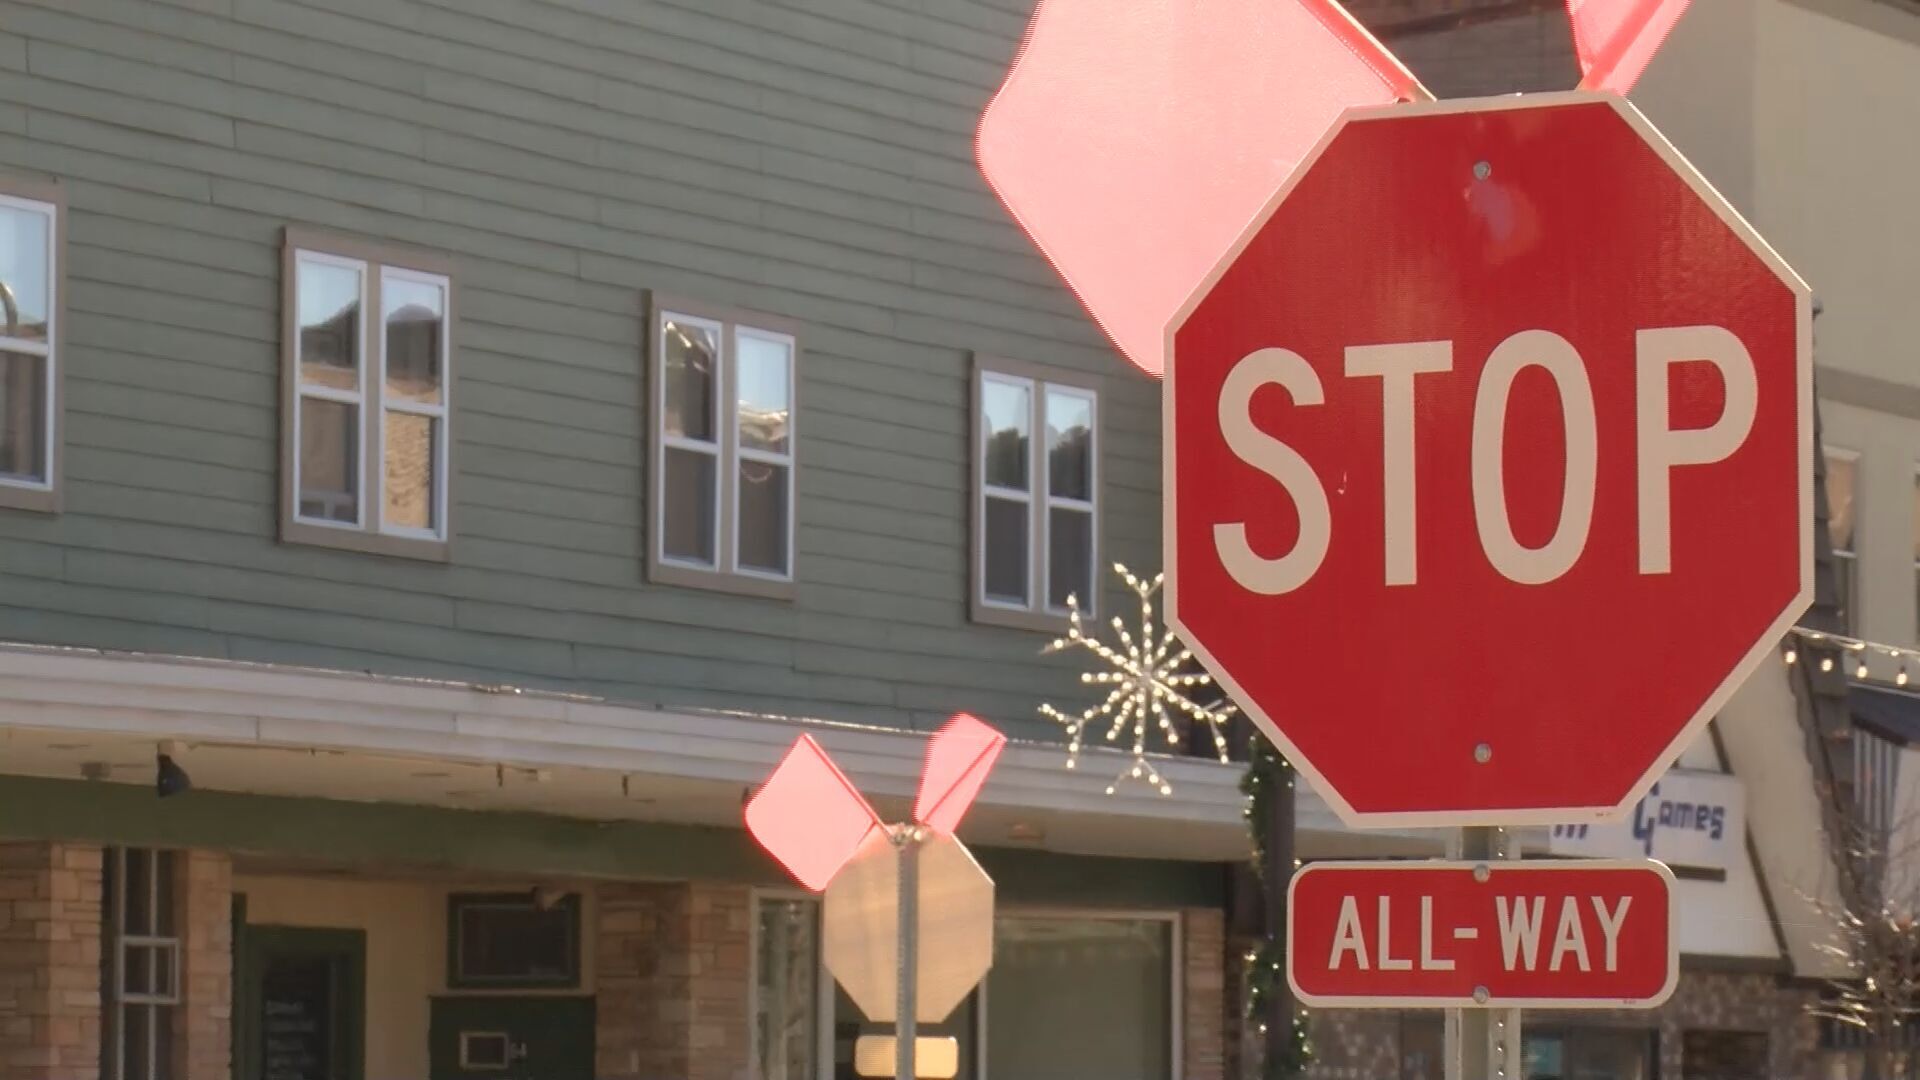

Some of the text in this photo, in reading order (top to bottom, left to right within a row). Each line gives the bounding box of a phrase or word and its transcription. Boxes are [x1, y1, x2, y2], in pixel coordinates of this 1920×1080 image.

[1213, 325, 1758, 595] STOP
[1632, 783, 1725, 857] Games
[1328, 895, 1633, 972] ALL-WAY
